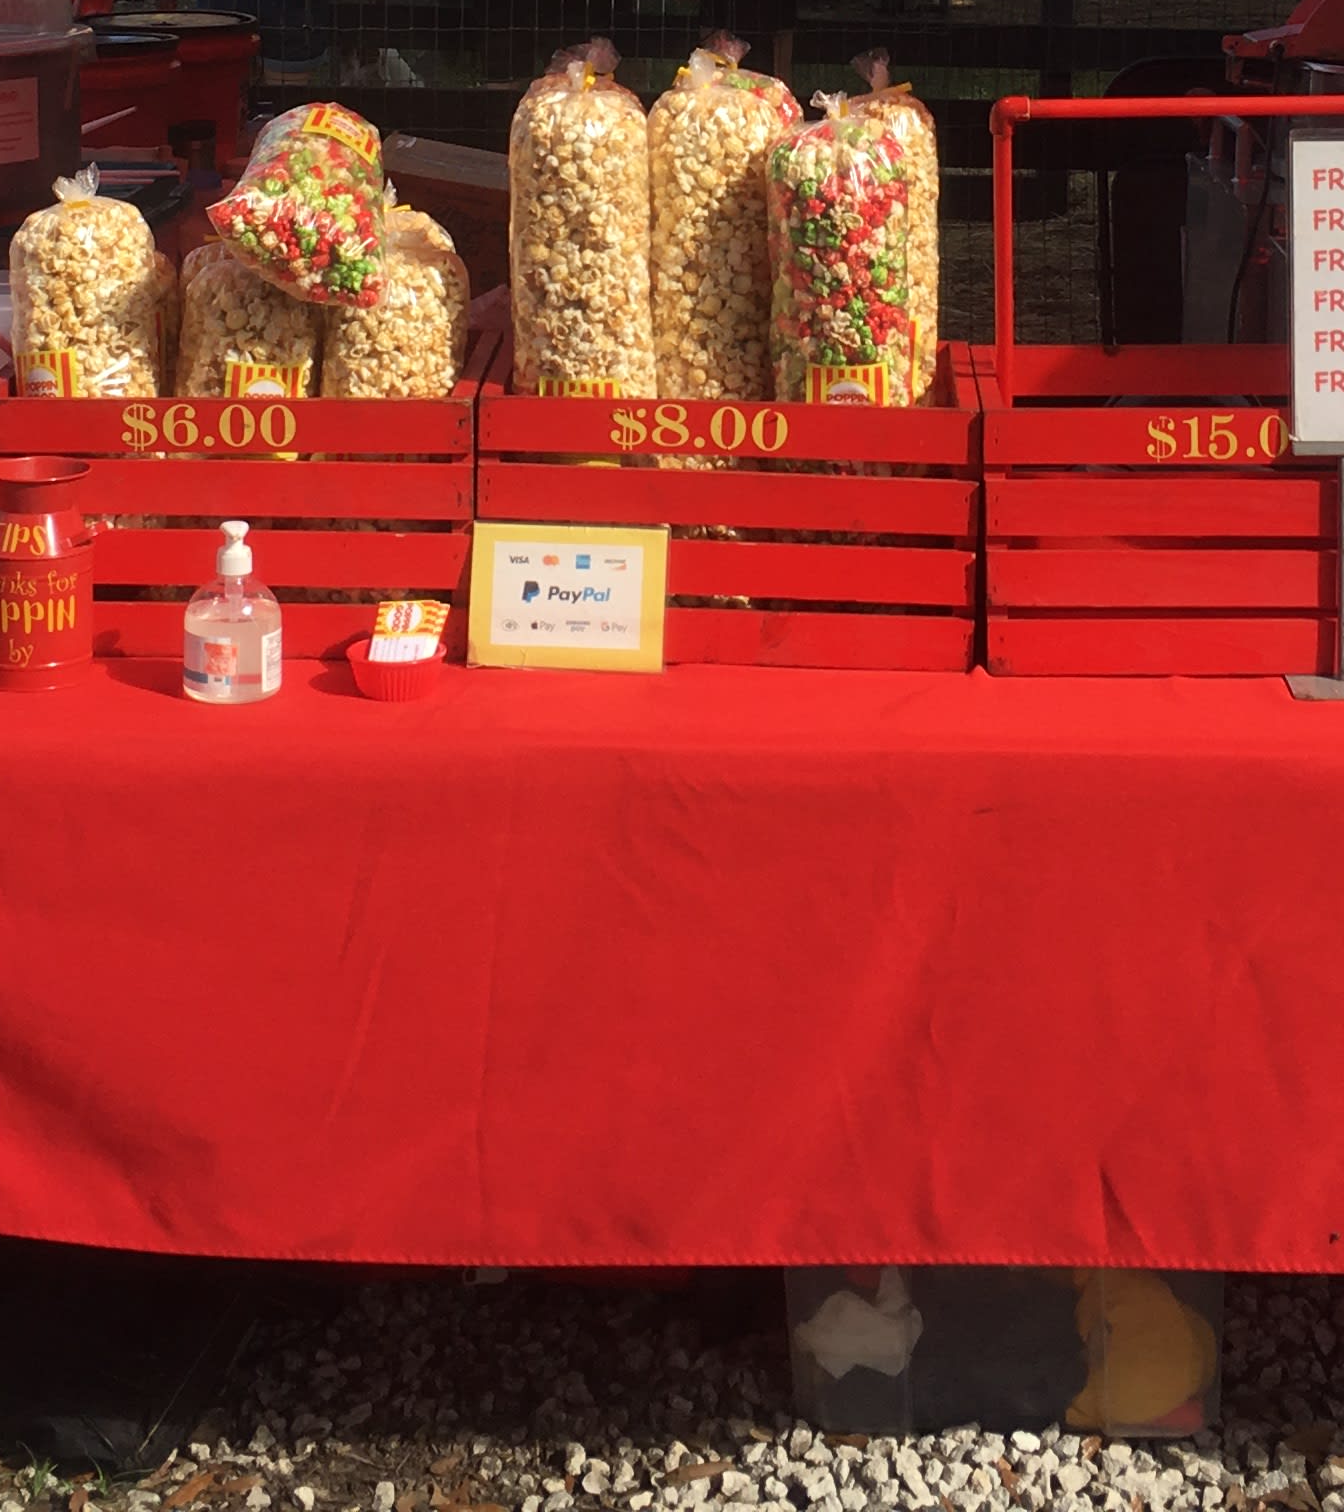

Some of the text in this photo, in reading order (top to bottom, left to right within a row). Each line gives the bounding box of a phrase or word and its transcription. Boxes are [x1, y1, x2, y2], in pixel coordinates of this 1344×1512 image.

[121, 403, 297, 451] $6.00
[609, 405, 789, 451] $8.00
[509, 555, 530, 564] VISA
[47, 569, 79, 595] for
[547, 586, 612, 604] PayPal
[539, 619, 556, 633] Pay
[7, 638, 34, 667] by
